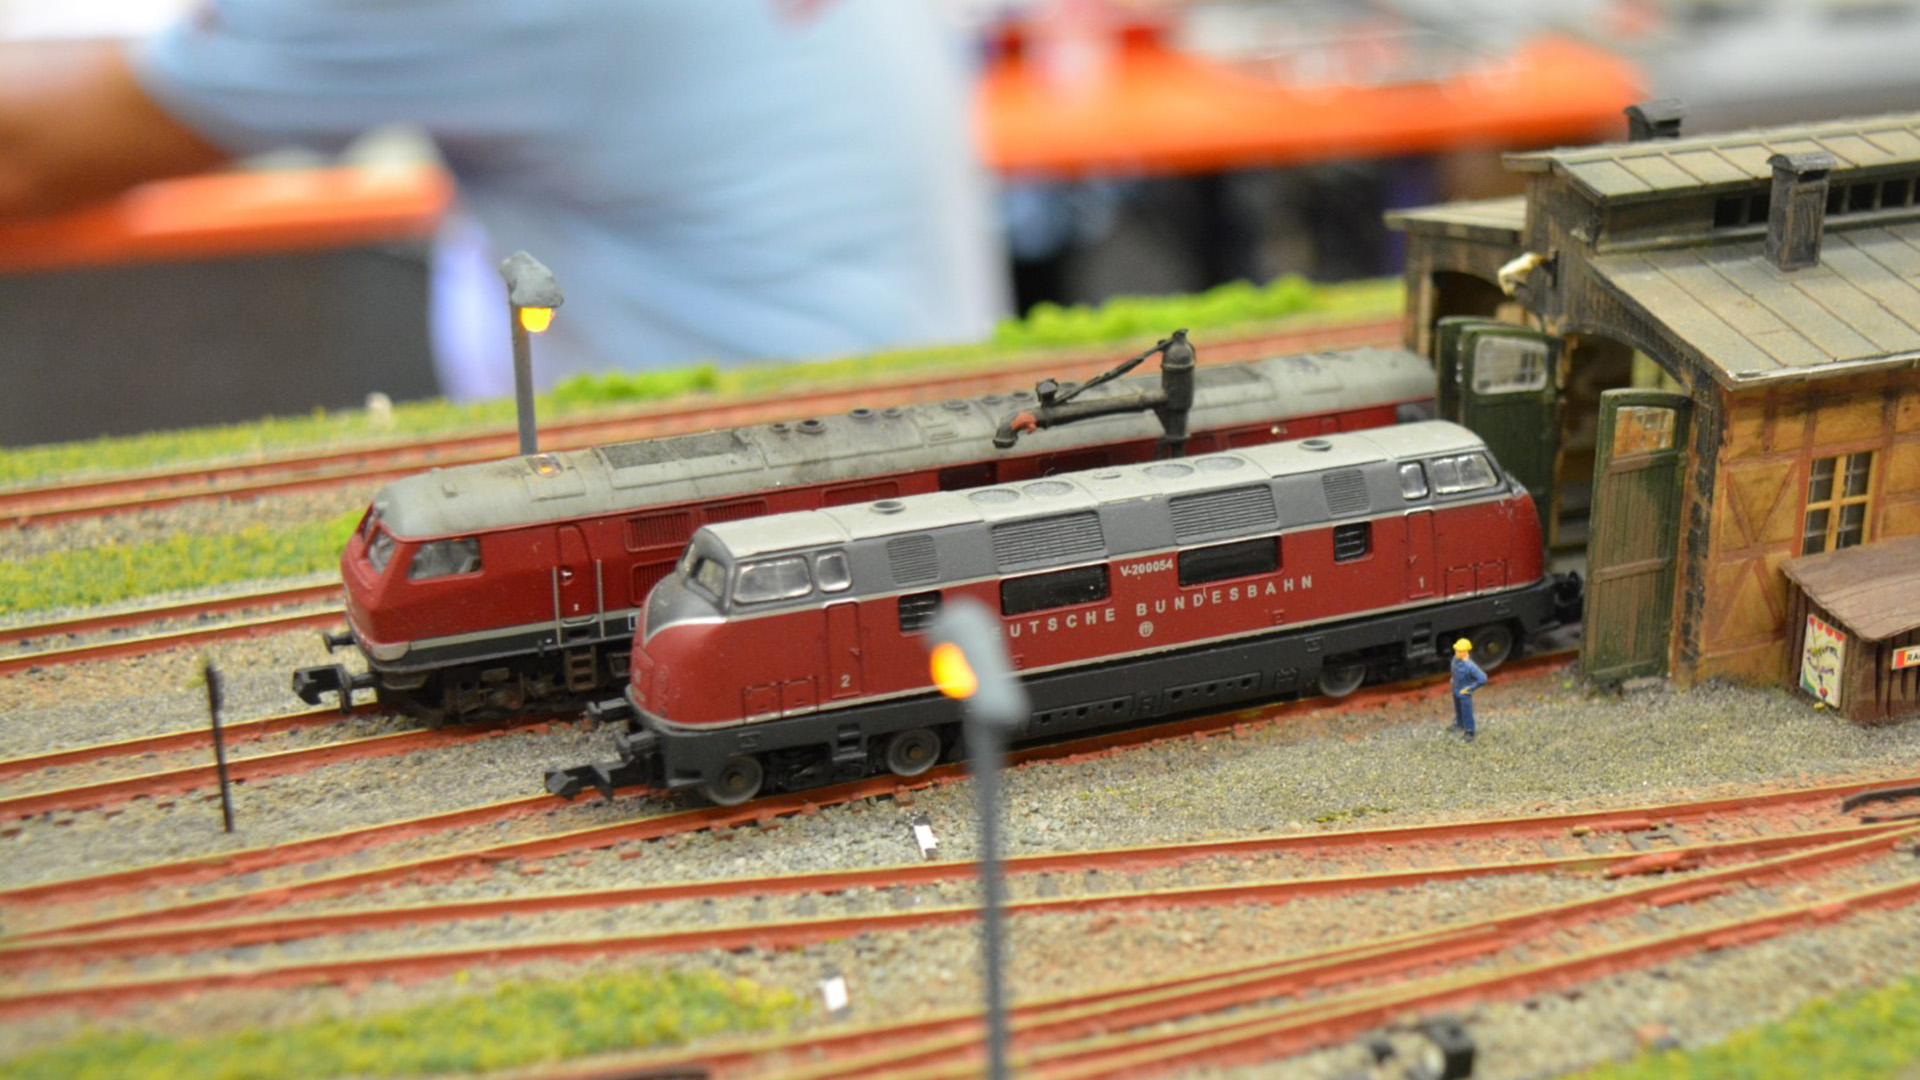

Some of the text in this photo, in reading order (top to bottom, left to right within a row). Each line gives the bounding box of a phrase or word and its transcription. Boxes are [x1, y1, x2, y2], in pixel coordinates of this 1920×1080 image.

[1120, 558, 1173, 577] V-200054
[1418, 576, 1424, 589] 1
[1136, 575, 1312, 616] BUNDESBAHN
[841, 674, 850, 688] 2
